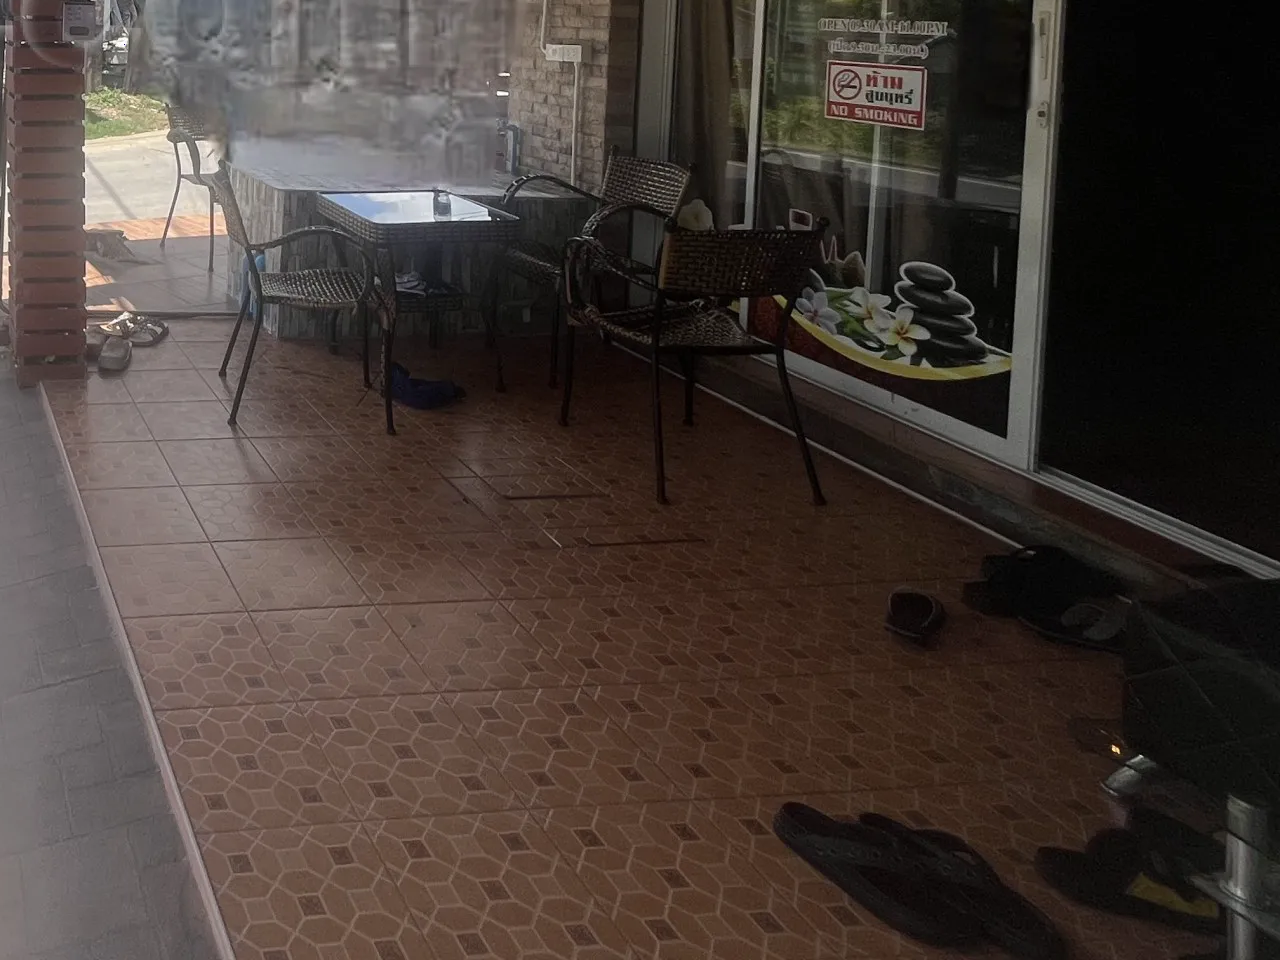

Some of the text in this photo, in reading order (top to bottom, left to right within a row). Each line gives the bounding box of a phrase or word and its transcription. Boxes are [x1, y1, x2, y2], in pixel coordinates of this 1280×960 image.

[818, 18, 849, 32] OPEN
[866, 71, 903, 89] ห้าม
[865, 89, 914, 105] สูบบุหรี่
[830, 104, 918, 125] NO SMOKING
